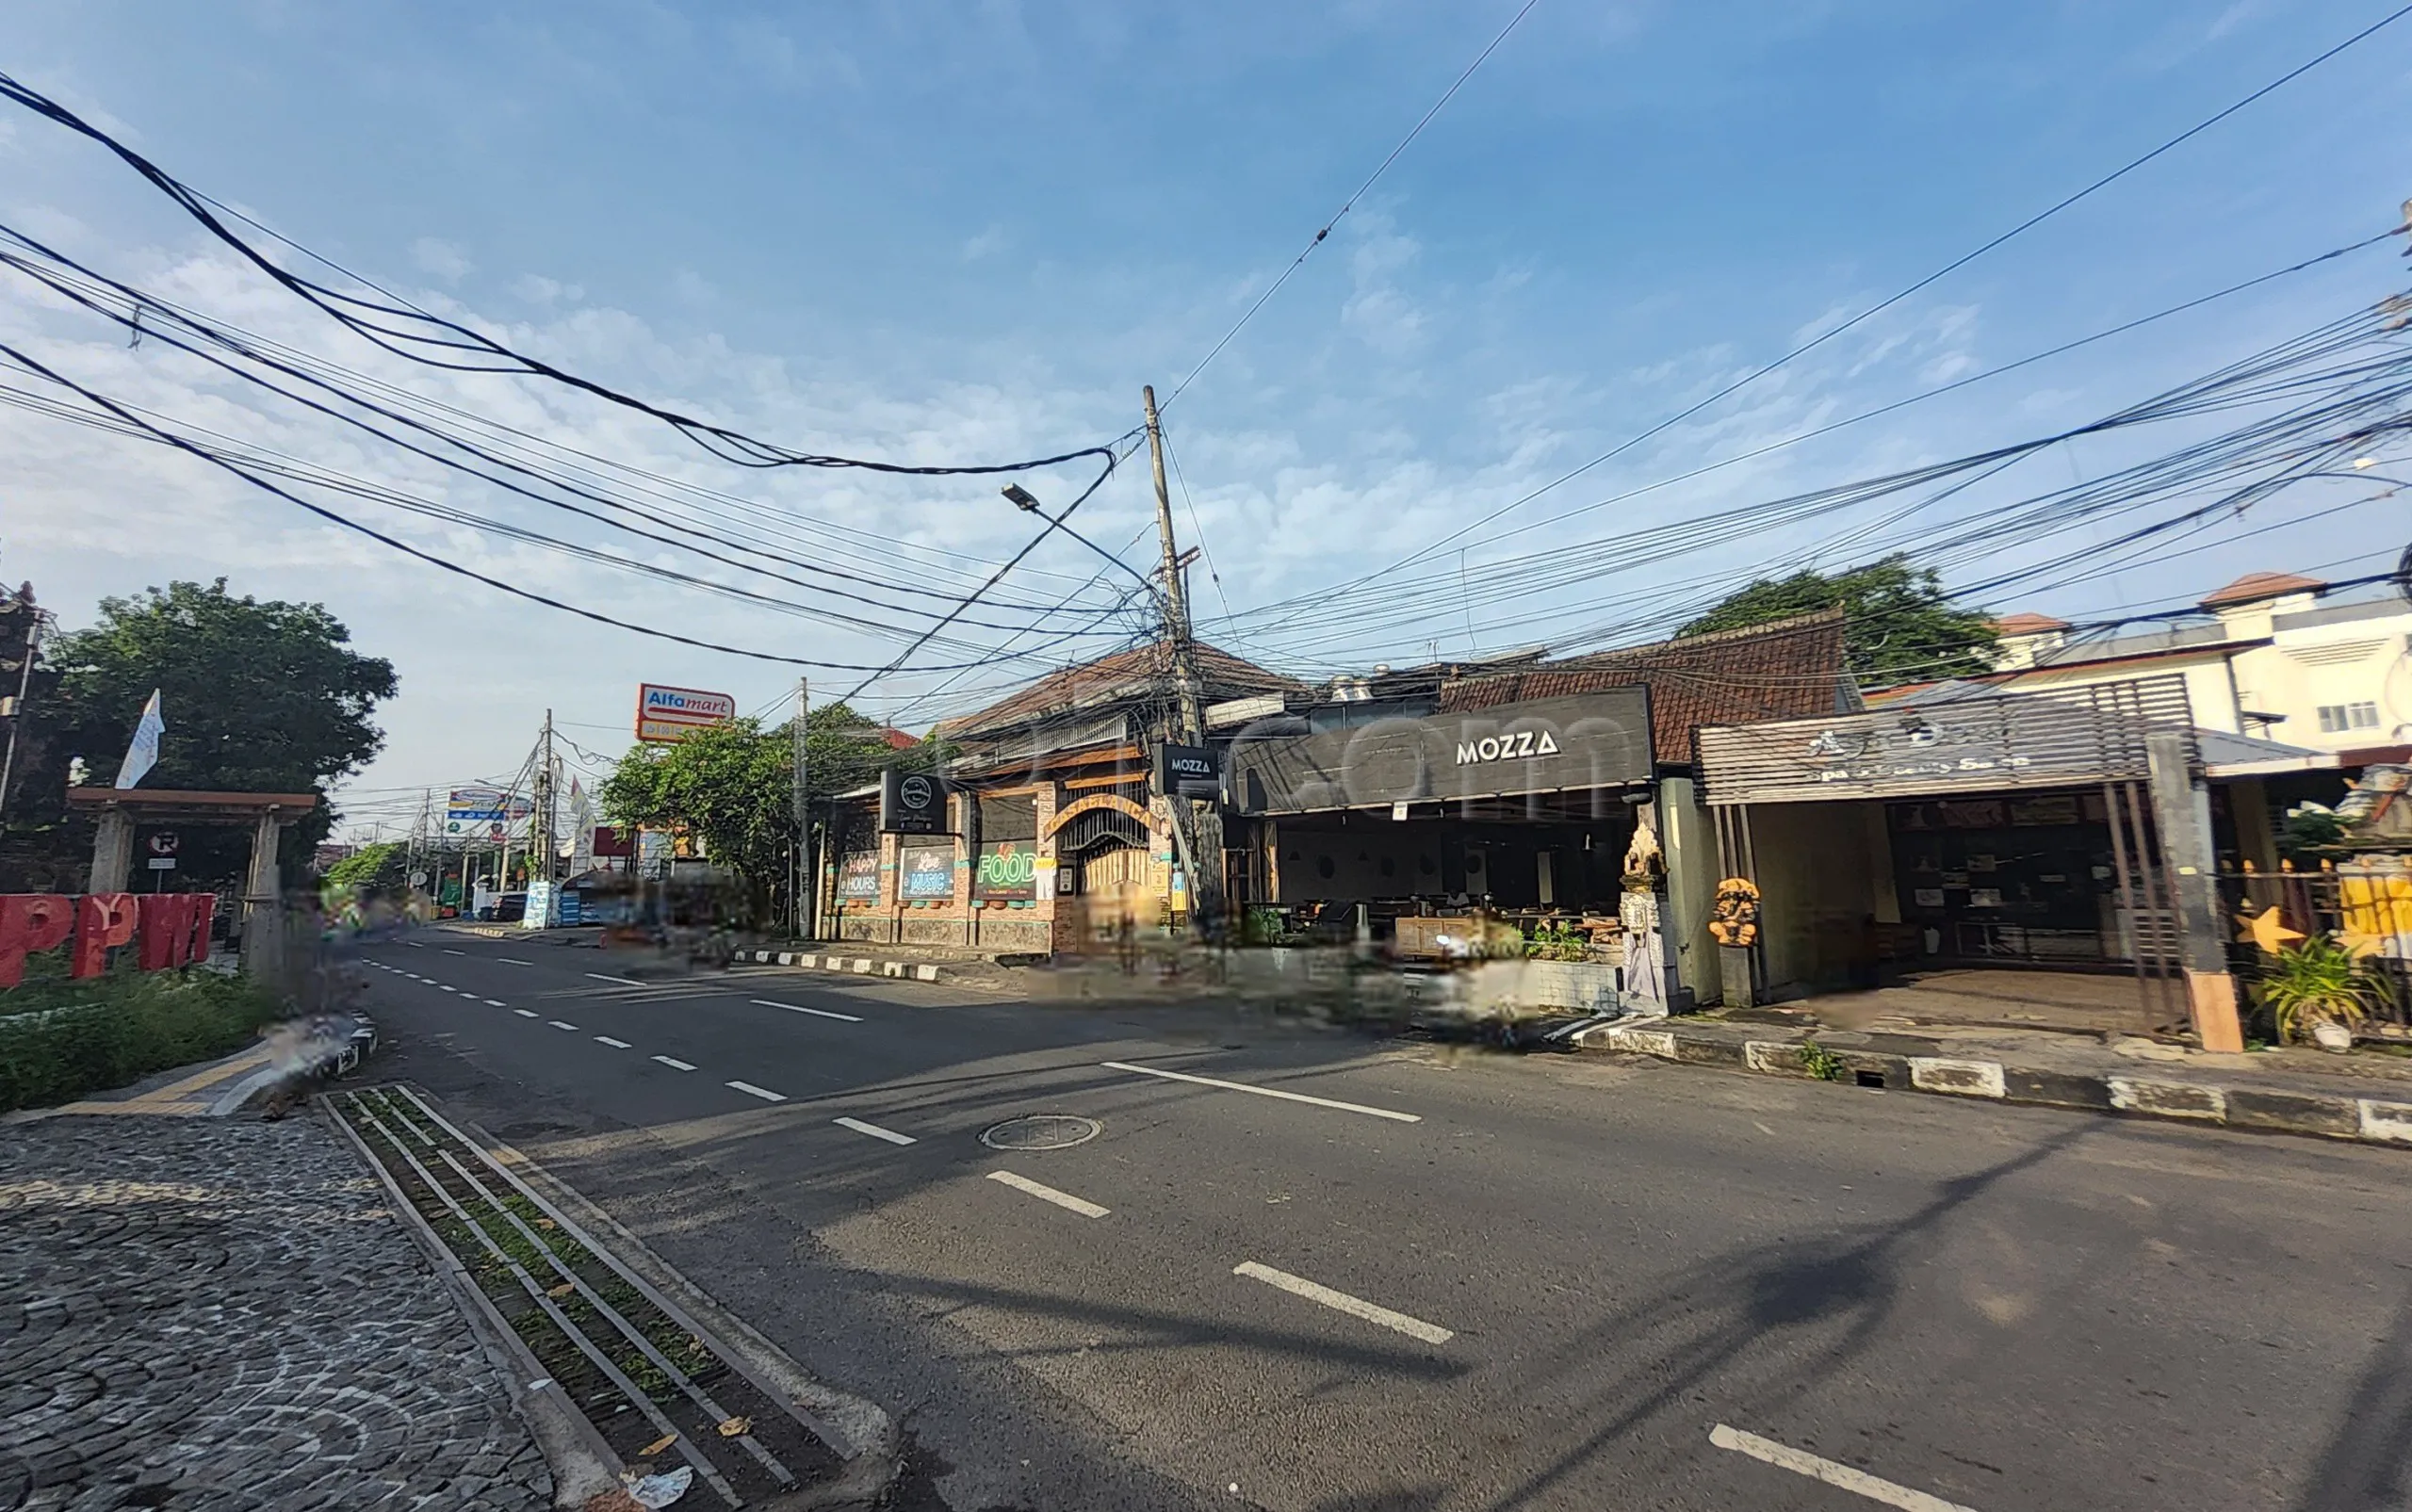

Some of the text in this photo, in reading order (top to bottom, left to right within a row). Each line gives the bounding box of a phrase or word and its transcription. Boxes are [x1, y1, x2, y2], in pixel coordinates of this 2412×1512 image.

[648, 691, 728, 713] Alfamart
[1457, 730, 1560, 765] MOZZA
[1171, 757, 1211, 773] MOZZA
[848, 858, 878, 872] HAPPY
[978, 853, 1037, 884] FOOD
[846, 876, 876, 891] HOURS
[910, 872, 945, 891] MUSIC
